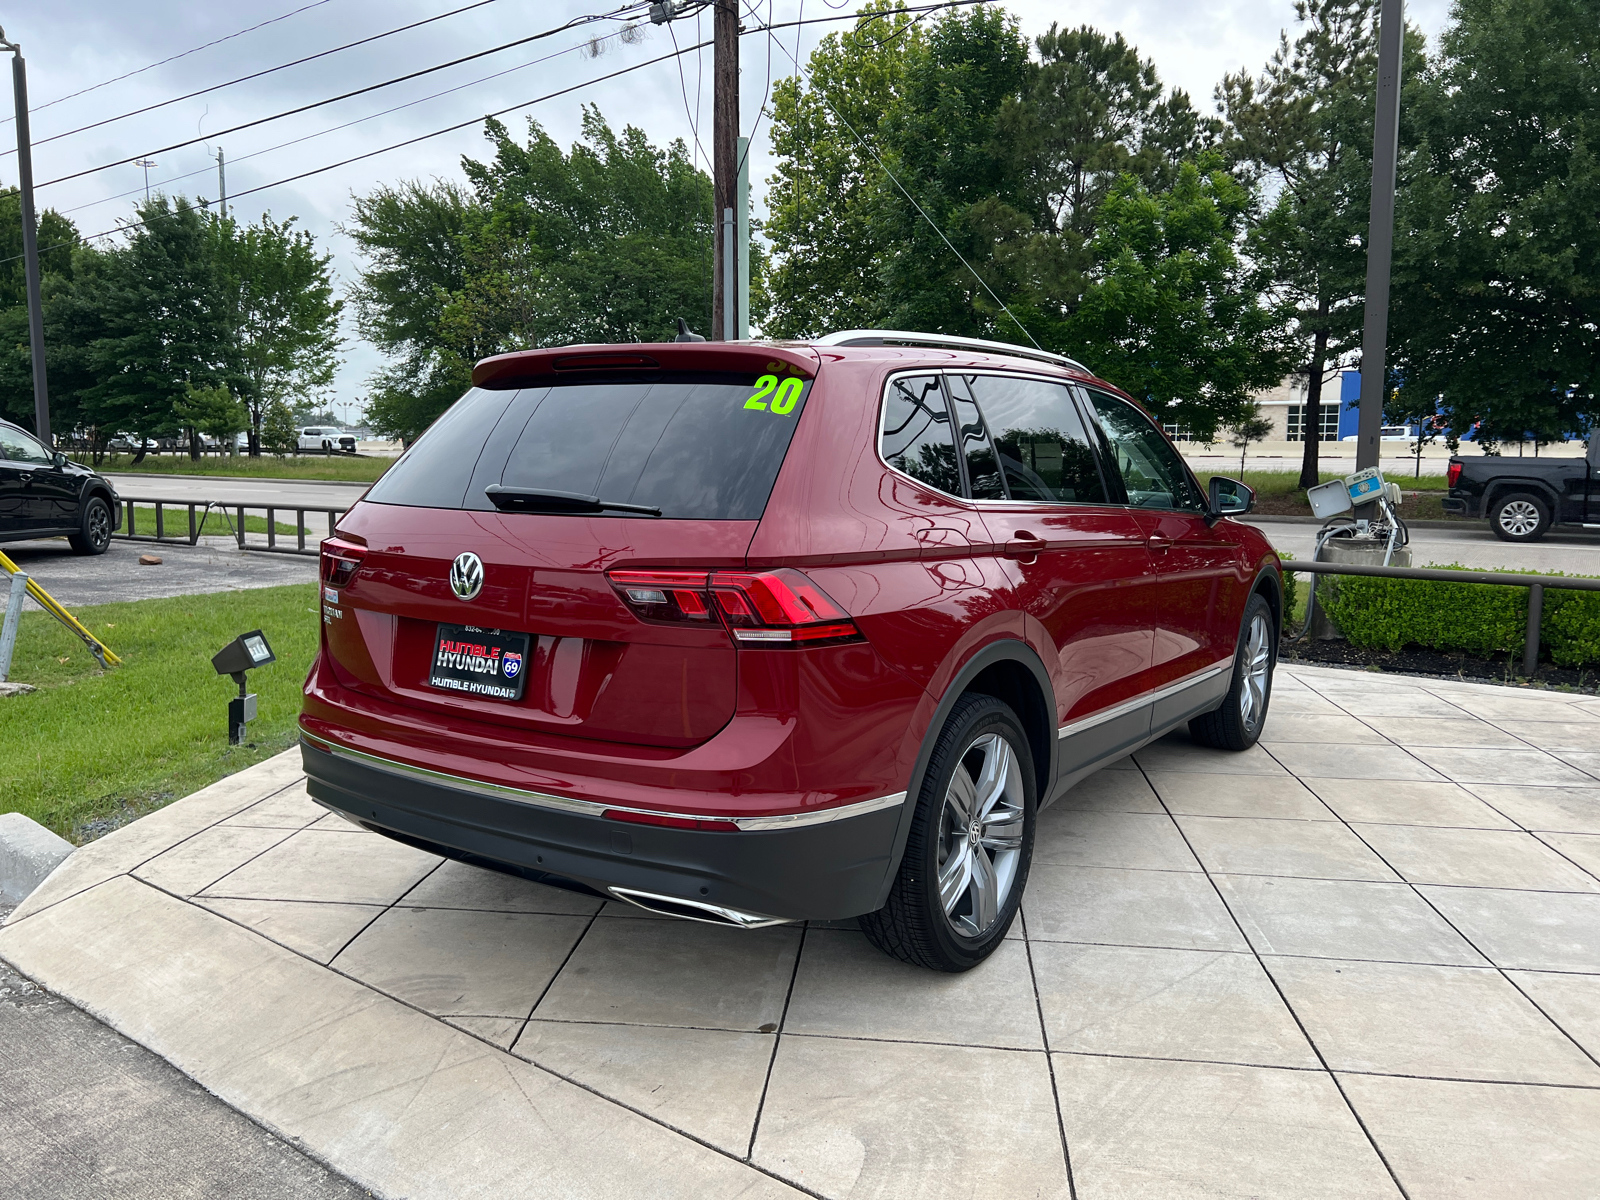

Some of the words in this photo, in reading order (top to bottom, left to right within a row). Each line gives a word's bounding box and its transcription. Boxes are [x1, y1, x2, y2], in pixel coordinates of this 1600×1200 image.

[743, 374, 804, 415] 20
[439, 639, 501, 660] HUMBLE
[436, 651, 499, 676] HYUNDAI
[504, 661, 518, 674] 69
[431, 676, 470, 691] HUMBLE
[469, 682, 510, 698] HYUNDAI
